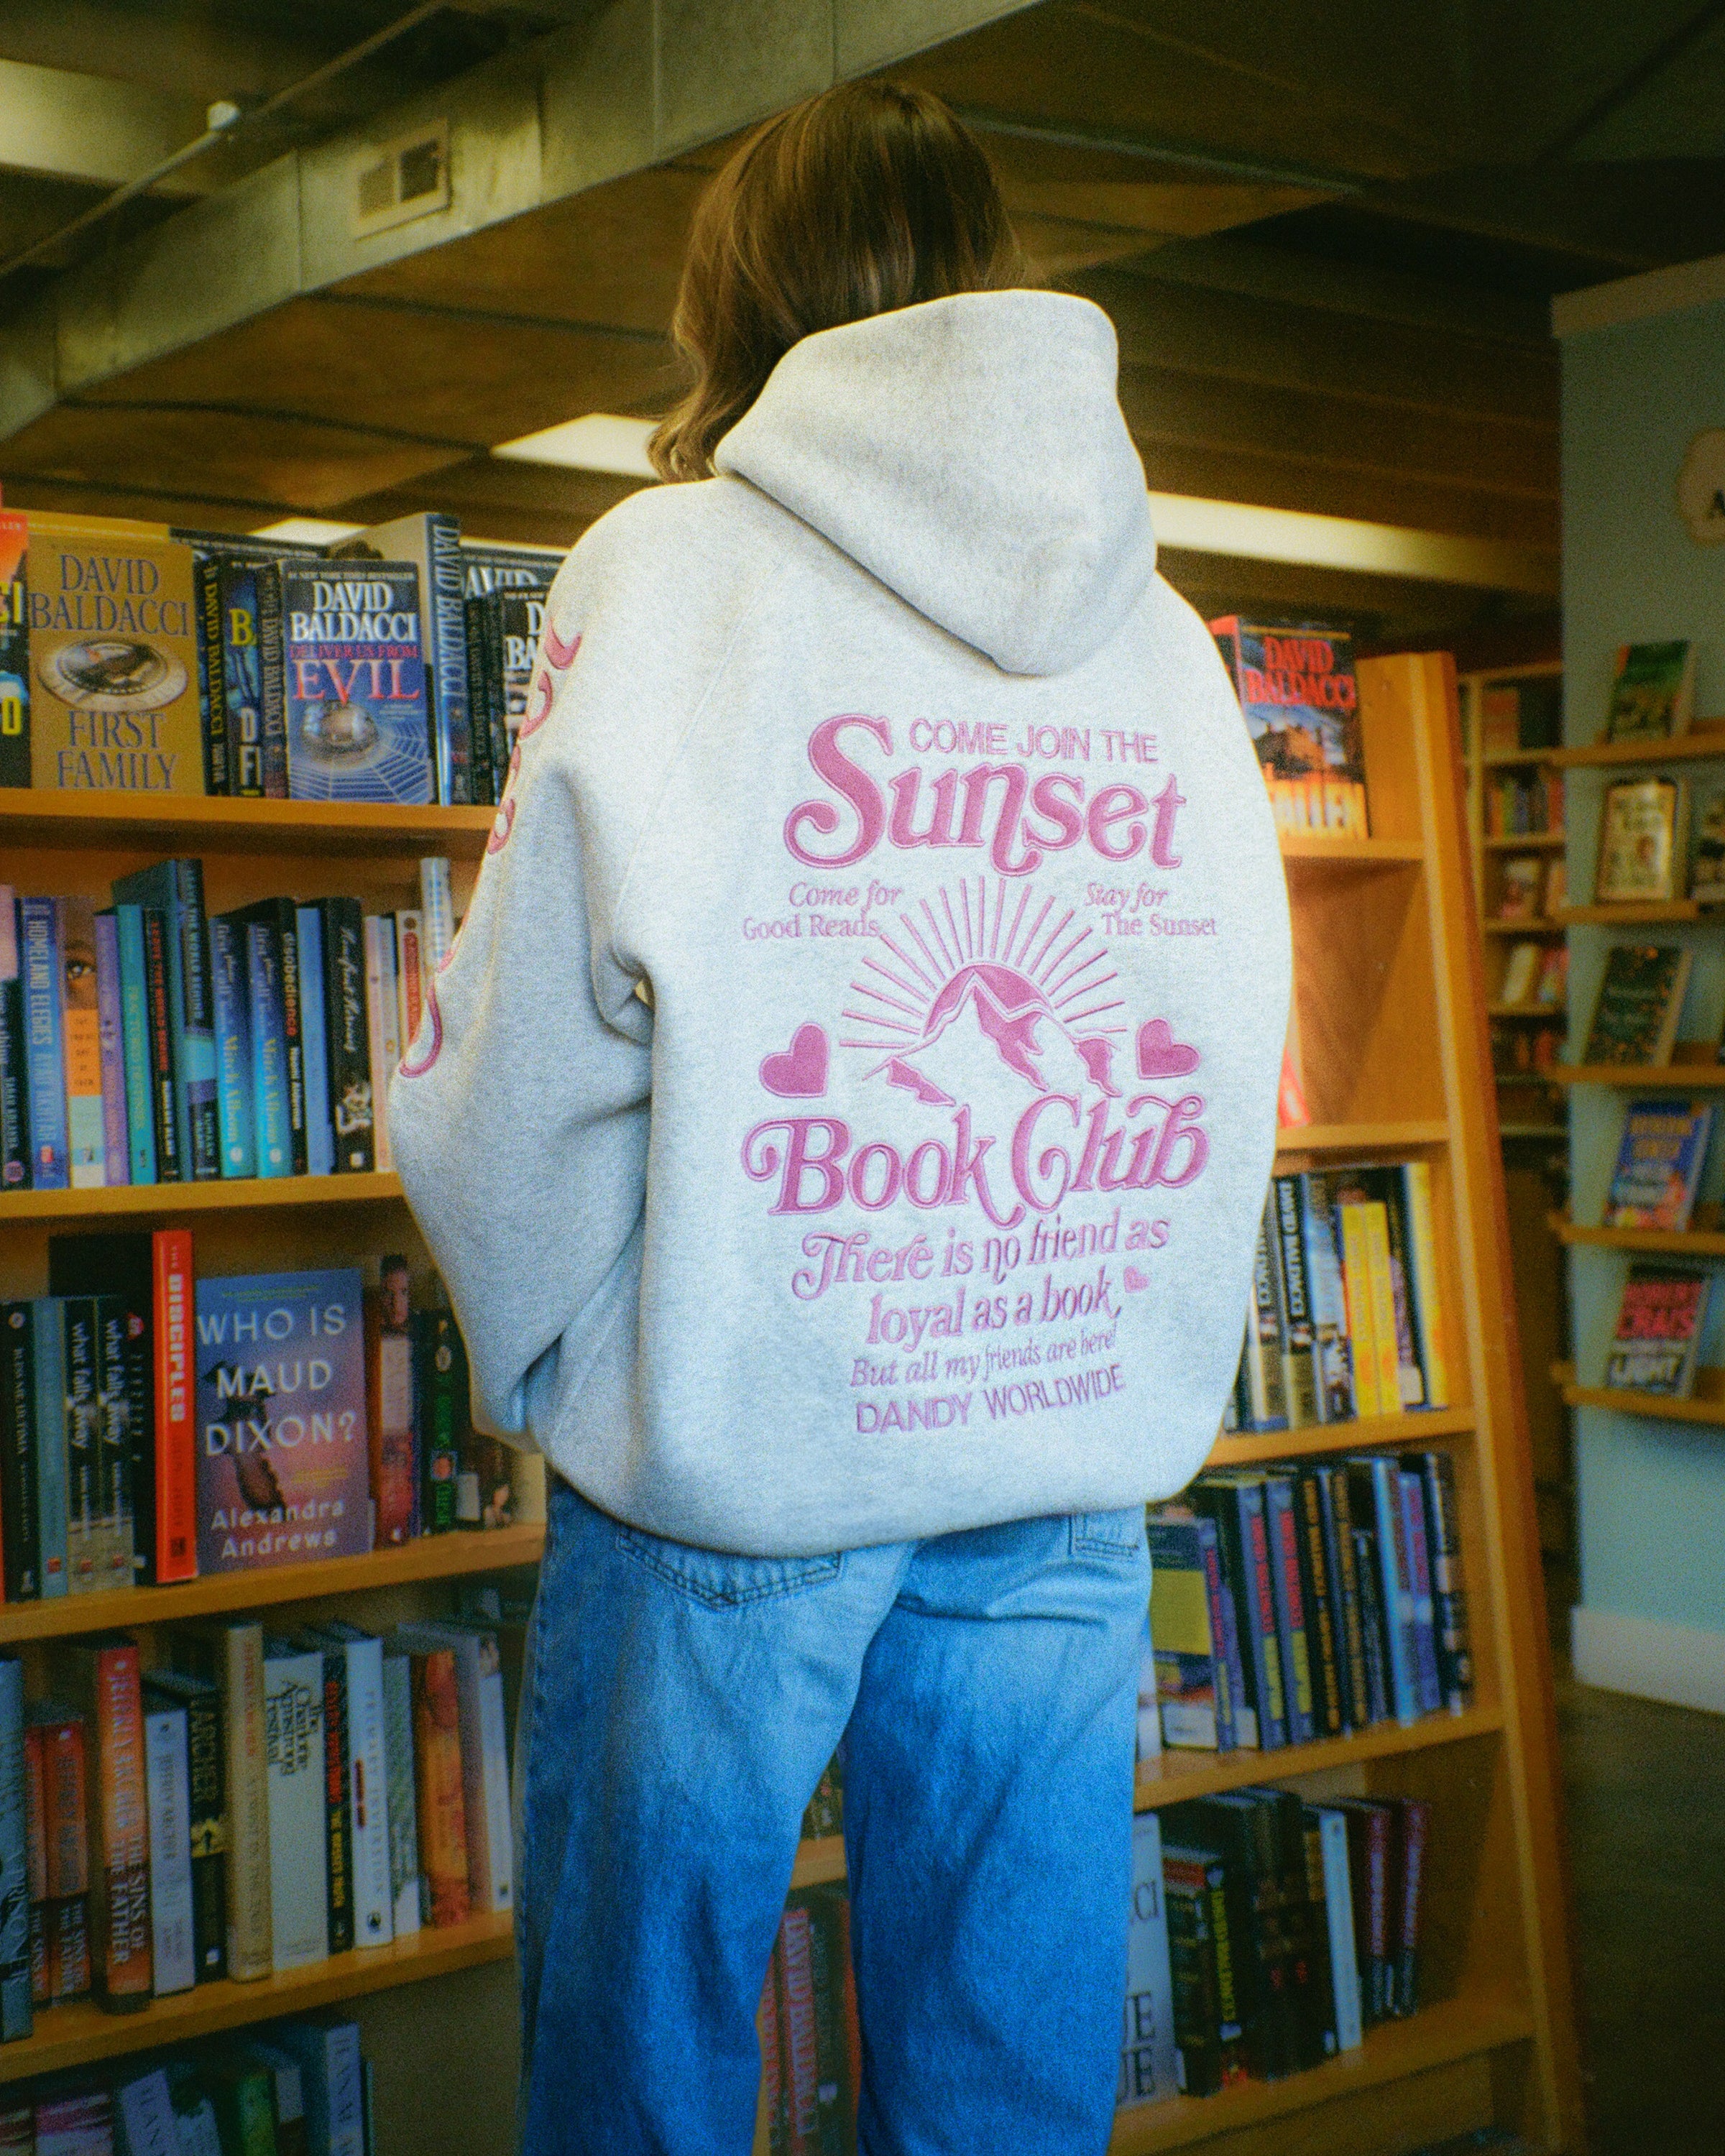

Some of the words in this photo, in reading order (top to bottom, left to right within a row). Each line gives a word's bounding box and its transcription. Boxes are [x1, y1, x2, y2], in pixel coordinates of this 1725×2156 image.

[60, 554, 160, 595] DAVID
[433, 525, 460, 591] DAVID
[313, 581, 394, 612] DAVID
[465, 566, 538, 599] AVID
[30, 593, 191, 637] BALDACCI
[203, 583, 221, 640] DAVID
[291, 612, 417, 642] BALDACCI
[262, 618, 282, 662] DAVID
[290, 645, 353, 658] DELIVER
[356, 645, 374, 658] US
[378, 645, 418, 658] FROM
[437, 596, 466, 697] BALDACCI
[1264, 636, 1334, 672] DAVID
[208, 646, 224, 736] BALDACCI
[264, 665, 284, 737] BALDACCI
[293, 659, 420, 706] EVIL
[1245, 669, 1357, 708] BALDACCI
[68, 710, 165, 750] FIRST
[910, 718, 1007, 755] COME
[1018, 724, 1089, 760] JOIN
[1099, 729, 1159, 764] THE
[57, 750, 178, 790] FAMILY
[784, 714, 1186, 876] Sunset
[187, 907, 198, 930] THE
[789, 882, 859, 907] Come
[861, 879, 902, 913] for
[1085, 883, 1131, 913] Stay
[1129, 883, 1169, 913] for
[151, 922, 162, 959] LEAVE
[743, 913, 801, 940] Good
[809, 910, 879, 937] Reads
[1102, 912, 1143, 936] The
[1150, 913, 1218, 936] Sunset
[28, 920, 50, 989] HOMELAND
[153, 964, 164, 985] THE
[189, 933, 201, 973] WORLD
[154, 987, 165, 1027] WORLD
[192, 976, 203, 1019] BEHIND
[30, 995, 53, 1046] ELEGIES
[282, 932, 298, 1036] disobedience
[291, 1082, 302, 1129] Alderman
[157, 1030, 168, 1072] BEHIND
[224, 1036, 238, 1083] Mitch
[262, 1038, 278, 1084] Mitch
[226, 1089, 240, 1142] Albom
[265, 1090, 278, 1144] Albom
[742, 1105, 1026, 1230] Book
[1011, 1092, 1210, 1213] Club
[1279, 1182, 1298, 1233] DAVID
[792, 1231, 933, 1301] There
[941, 1227, 973, 1277] is
[981, 1234, 1018, 1284] no
[1028, 1207, 1121, 1265] friend
[1125, 1218, 1171, 1250] as
[1284, 1235, 1304, 1316] BALDACCI
[105, 1319, 122, 1360] what
[198, 1307, 293, 1345] WHO
[310, 1303, 346, 1337] IS
[866, 1288, 965, 1353] loyal
[972, 1299, 1006, 1332] as
[1014, 1297, 1031, 1325] a
[72, 1323, 90, 1364] what
[168, 1273, 185, 1422] DISCIPLES
[850, 1358, 898, 1387] But
[904, 1351, 937, 1381] all
[945, 1356, 981, 1385] my
[983, 1339, 1041, 1381] friends
[1046, 1340, 1077, 1363] are
[1079, 1325, 1117, 1357] here!
[73, 1369, 91, 1402] falls
[105, 1365, 126, 1398] falls
[216, 1359, 333, 1400] MAUD
[855, 1393, 972, 1434] DANDY
[983, 1365, 1126, 1420] WORLDWIDE
[16, 1405, 27, 1455] ULTIMA
[70, 1406, 89, 1449] away
[103, 1402, 123, 1445] away
[206, 1410, 356, 1457] DIXON?
[211, 1496, 344, 1531] Alexandra
[221, 1528, 339, 1560] Andrews
[110, 1676, 133, 1749] JEFFREY
[267, 1695, 282, 1766] Festival
[280, 1681, 298, 1775] Armstrong
[295, 1686, 310, 1771] Charlotte
[309, 1704, 322, 1735] The
[190, 1711, 217, 1803] ARCHER
[113, 1754, 137, 1829] ARCHER
[110, 1840, 125, 1875] THE
[127, 1836, 143, 1866] THE
[367, 1788, 383, 1895] INVERSION
[129, 1873, 147, 1919] SINS
[111, 1881, 130, 1964] FATHER
[131, 1925, 147, 1951] OF
[785, 1916, 811, 1999] DAVID
[790, 2004, 817, 2137] BALDACCI
